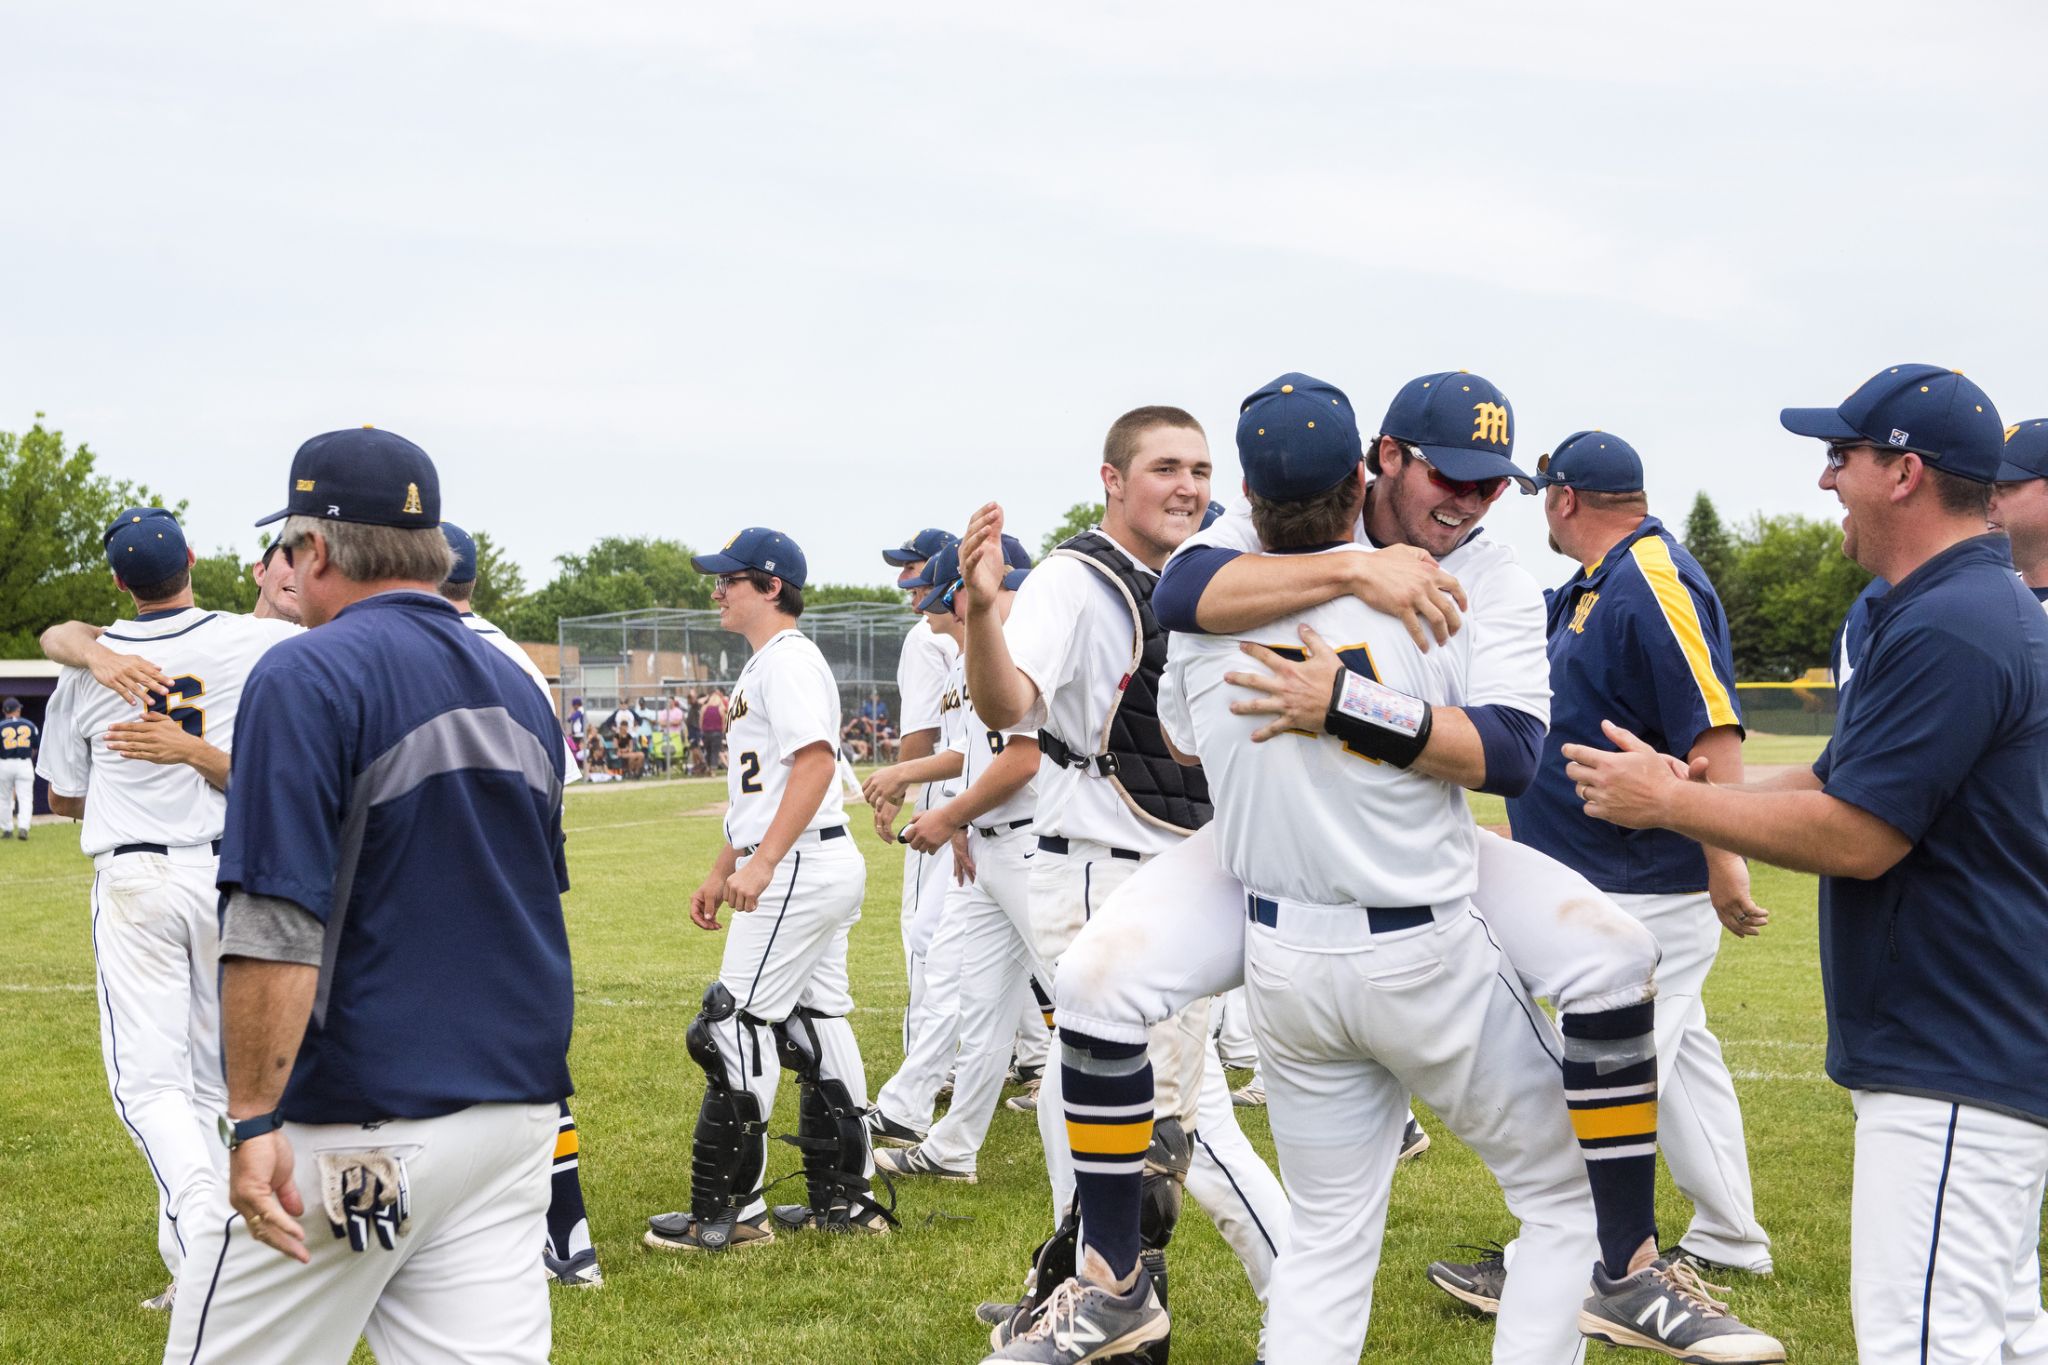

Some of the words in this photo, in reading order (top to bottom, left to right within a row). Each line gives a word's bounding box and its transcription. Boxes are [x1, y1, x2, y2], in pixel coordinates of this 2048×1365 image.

[1471, 401, 1510, 446] M
[1, 725, 31, 749] 22
[740, 751, 763, 793] 2
[1636, 1295, 1692, 1342] N
